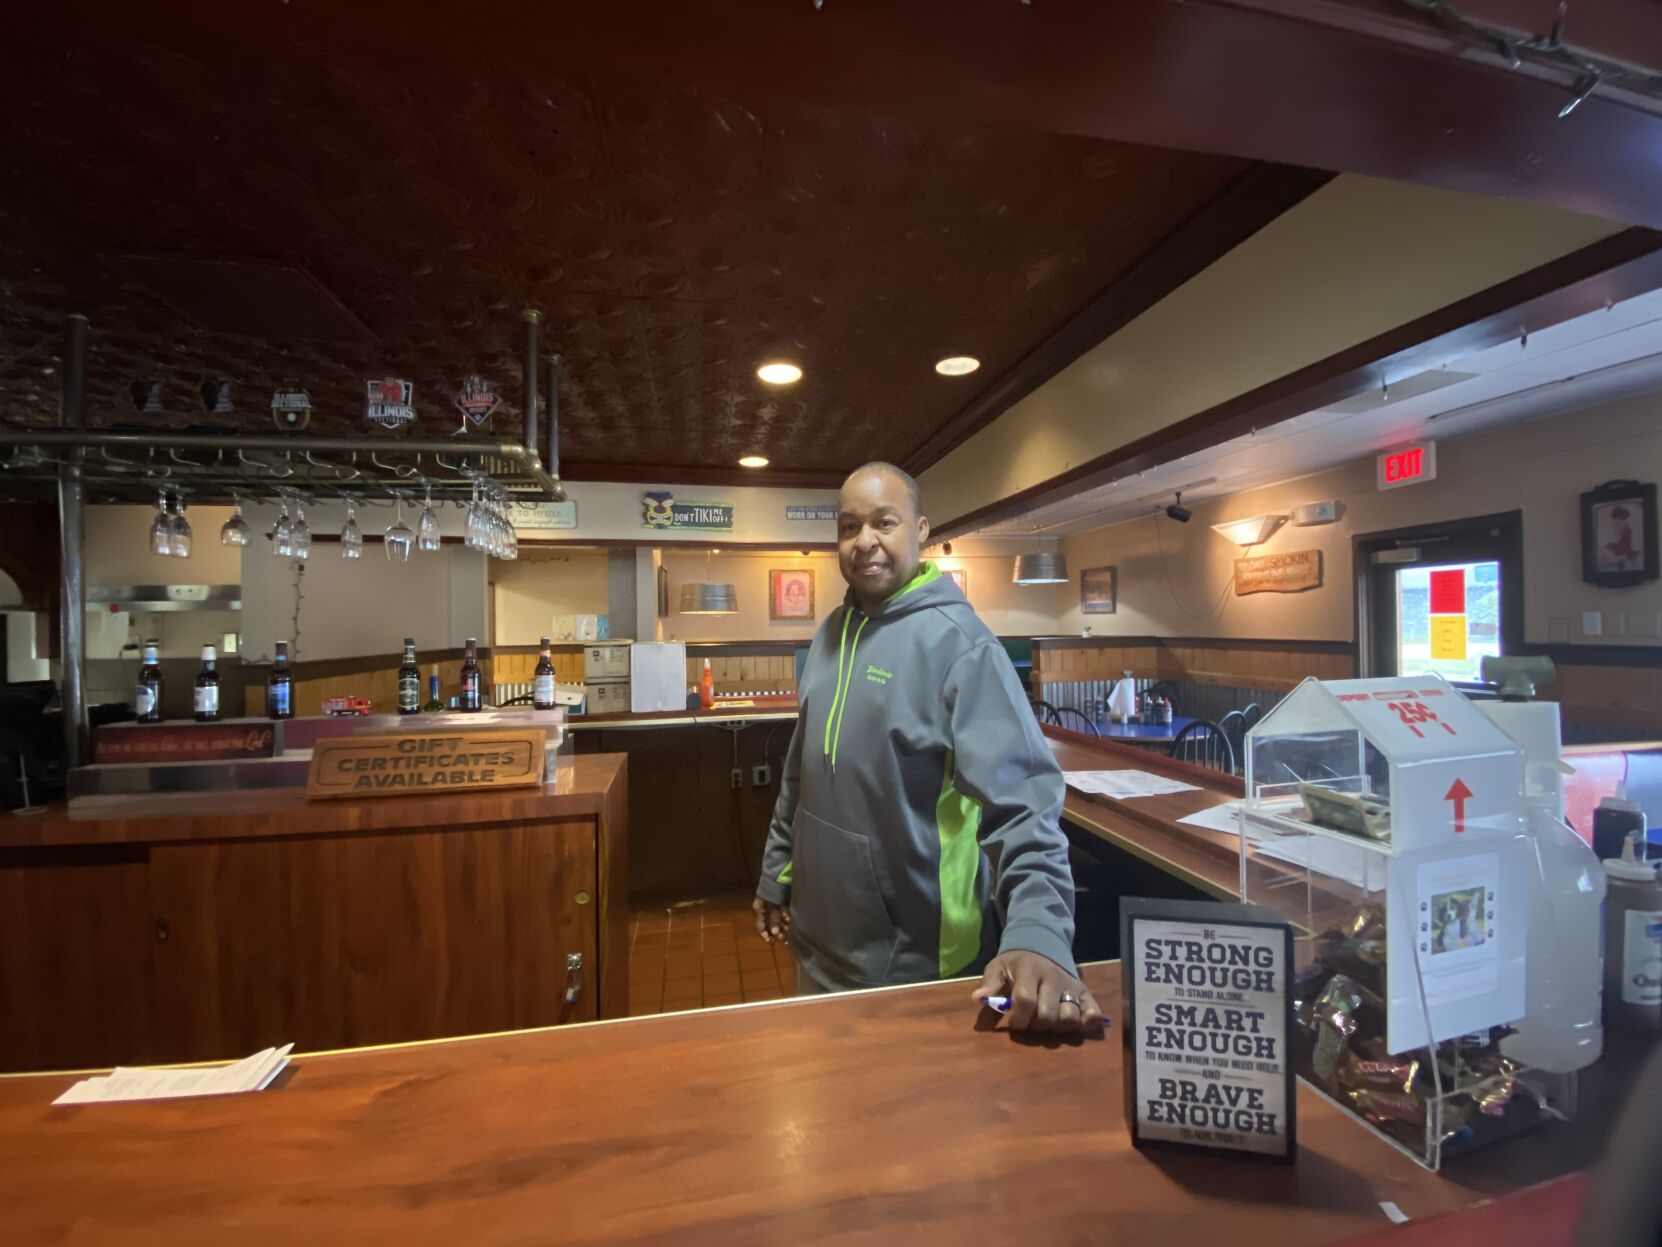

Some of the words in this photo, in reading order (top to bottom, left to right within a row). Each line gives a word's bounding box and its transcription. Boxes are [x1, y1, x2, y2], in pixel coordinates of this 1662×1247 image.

[461, 392, 493, 402] ILLINOIS
[367, 405, 413, 418] ILLINOIS
[1385, 448, 1424, 483] EXIT
[694, 507, 713, 522] TIKI
[787, 511, 805, 520] WORK
[806, 511, 816, 520] ON
[816, 511, 834, 520] YOUR
[397, 738, 463, 754] GIFT
[336, 751, 515, 772] CERTIFICATES
[354, 769, 495, 789] AVAILABLE
[1203, 929, 1217, 940] BE
[1144, 938, 1274, 968] STRONG
[1144, 961, 1276, 993] ENOUGH
[1174, 987, 1185, 997] TO
[1186, 988, 1214, 1000] STAND
[1155, 1003, 1265, 1033] SMART
[1146, 1026, 1277, 1059] ENOUGH
[1145, 1051, 1155, 1060] TO
[1158, 1053, 1182, 1063] KNOW
[1185, 1055, 1210, 1066] WHEN
[1212, 1057, 1229, 1068] YOU
[1231, 1059, 1253, 1071] NEED
[1201, 1069, 1221, 1081] AND
[1158, 1078, 1264, 1110] BRAVE
[1147, 1100, 1277, 1135] ENOUGH
